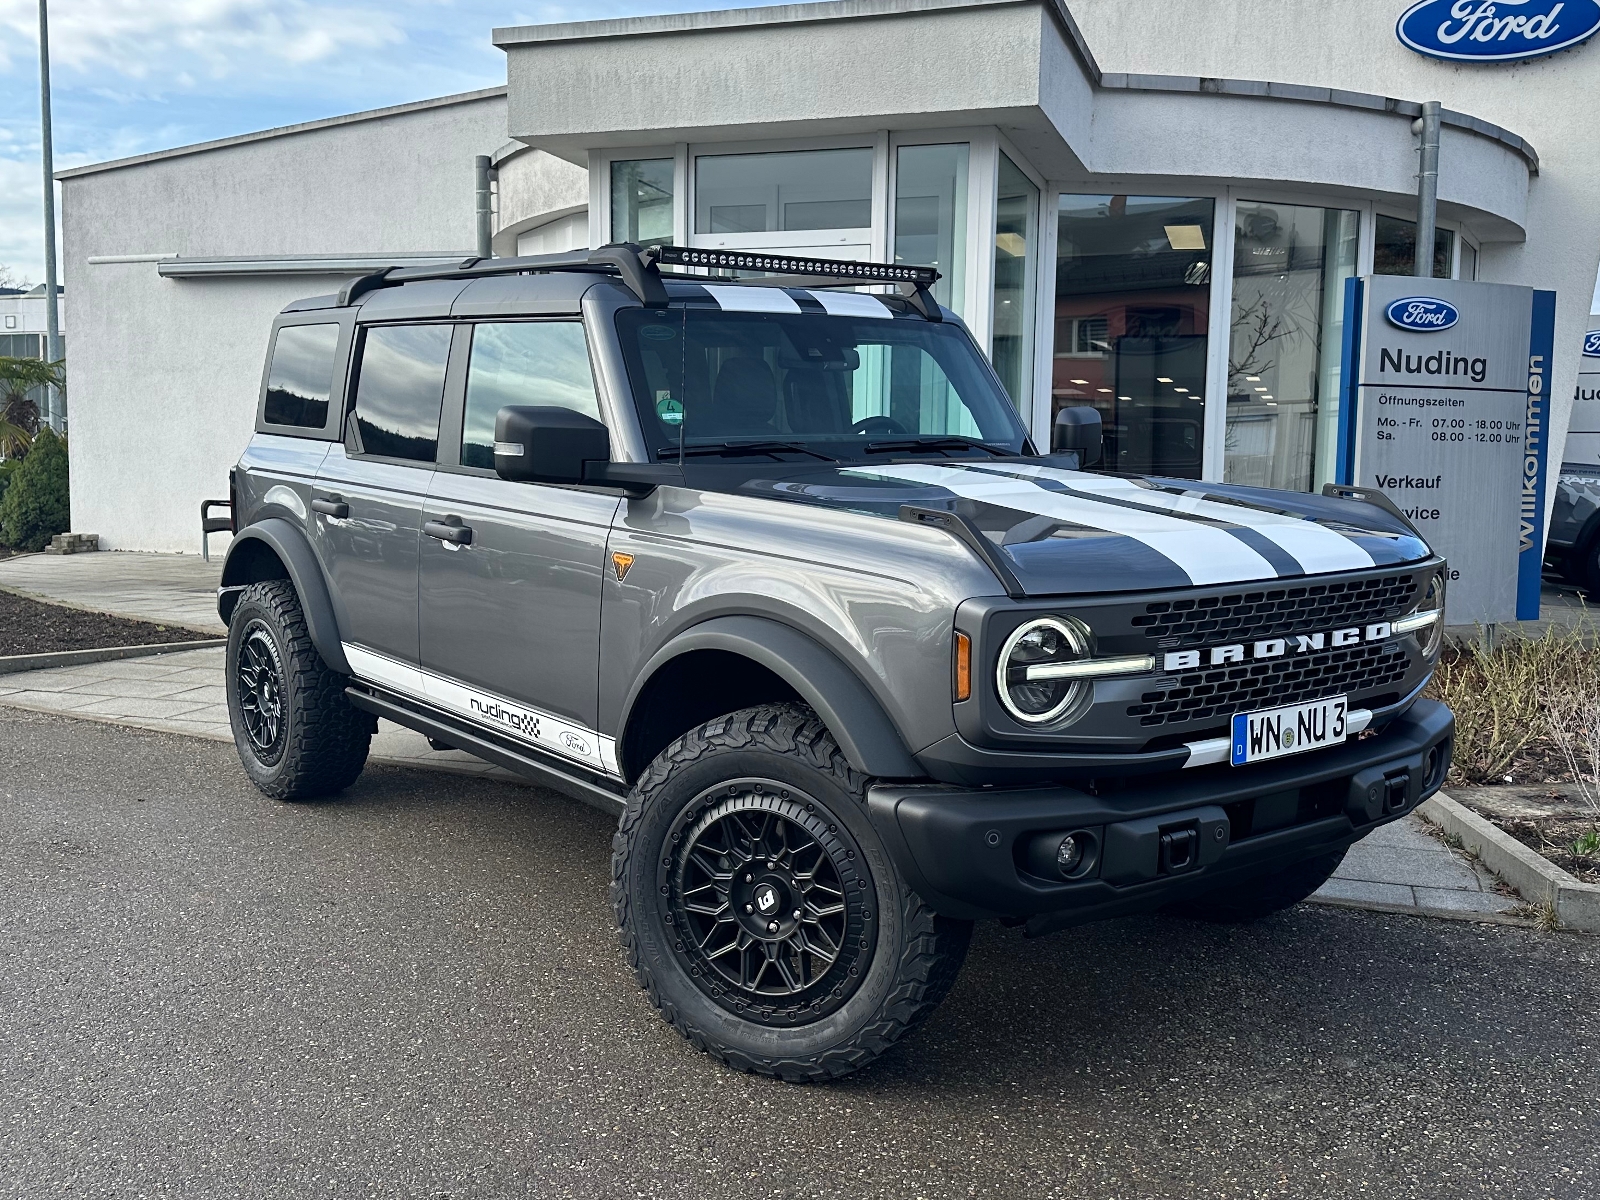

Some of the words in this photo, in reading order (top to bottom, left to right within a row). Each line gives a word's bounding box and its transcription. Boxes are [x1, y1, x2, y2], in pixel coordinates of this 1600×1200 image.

[1437, 0, 1565, 44] Ford
[1402, 302, 1447, 325] Ford
[1379, 347, 1487, 383] Nuding
[1378, 393, 1465, 408] Öffnungszeiten
[1409, 418, 1423, 428] Fr.
[1432, 418, 1465, 428] 07.00
[1475, 420, 1503, 430] 18.00
[1505, 421, 1521, 431] Uhr
[1376, 430, 1396, 440] Sa.
[1431, 432, 1464, 442] 08.00
[1475, 433, 1502, 443] 12.00
[1505, 434, 1520, 444] Uhr
[1518, 355, 1544, 553] Willkommen
[1375, 474, 1442, 489] Verkauf
[1404, 506, 1440, 520] vice
[1164, 622, 1391, 671] BRONCO
[470, 698, 522, 730] nuding
[1249, 714, 1281, 756] WN
[1297, 705, 1327, 746] NU
[1332, 701, 1346, 738] 3
[565, 733, 586, 752] Ford
[1236, 744, 1243, 756] D
